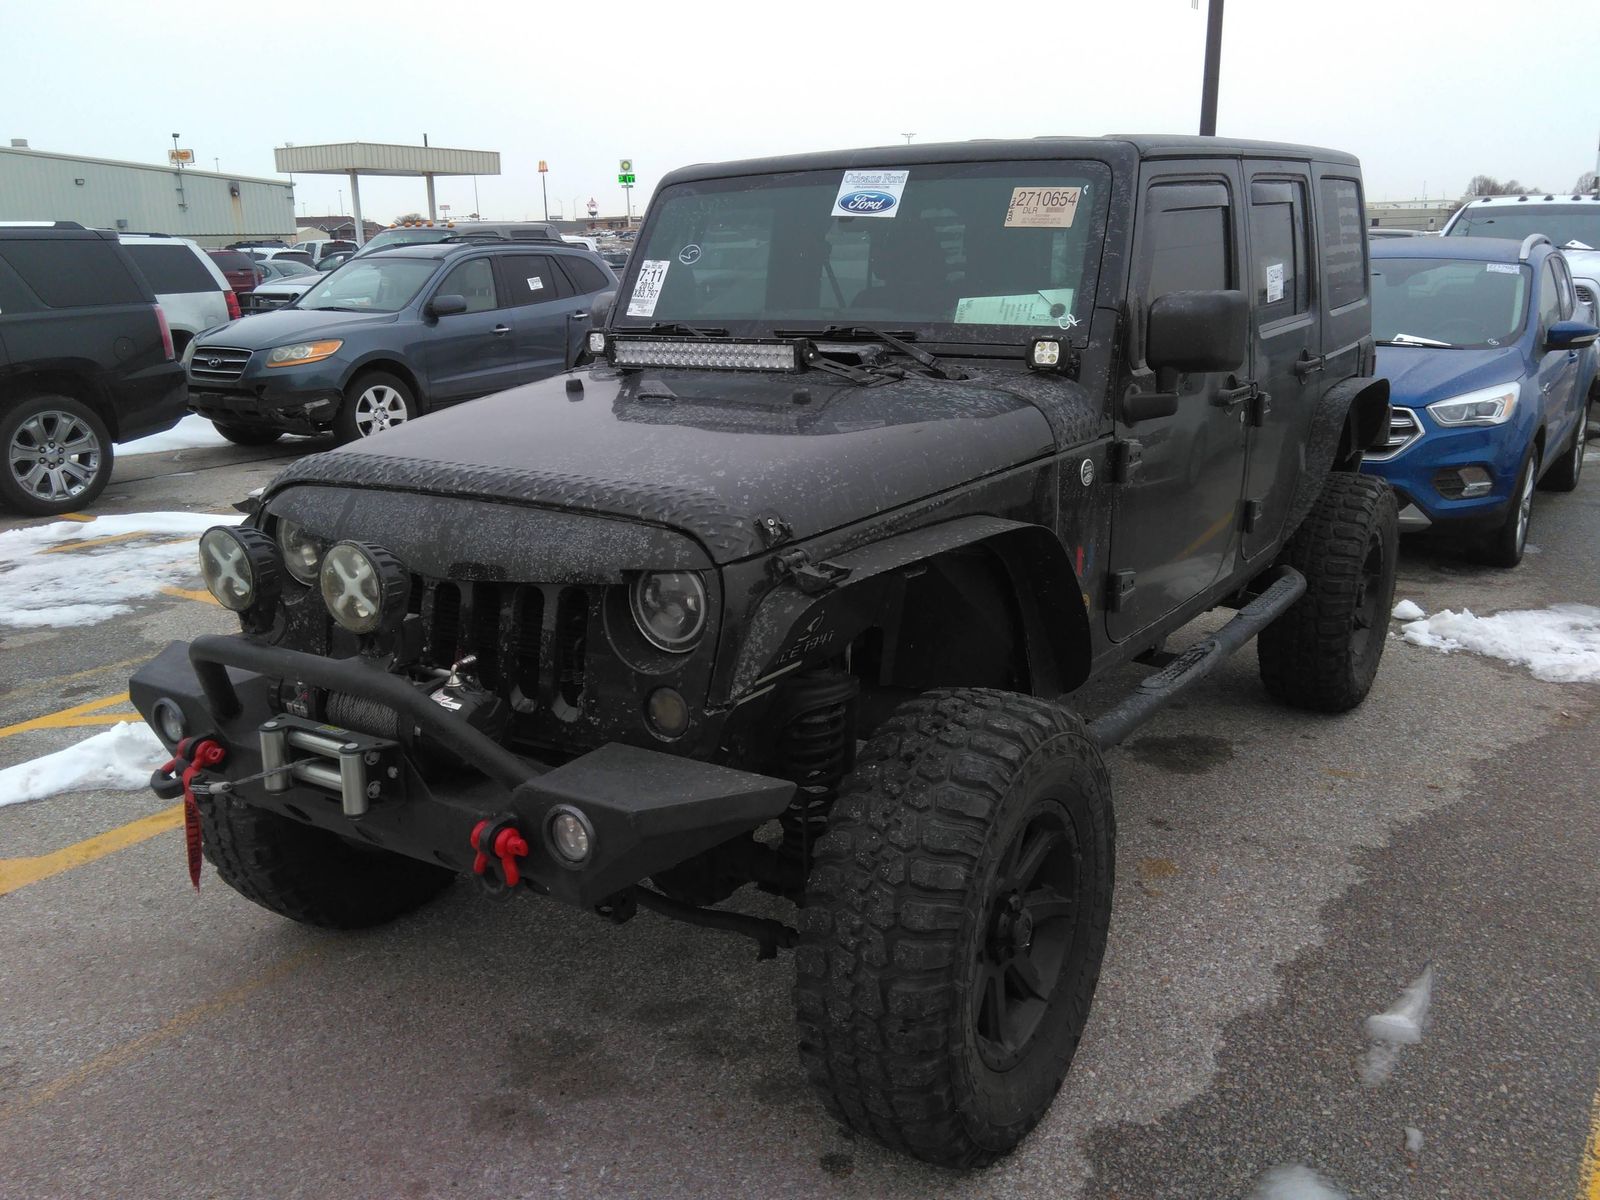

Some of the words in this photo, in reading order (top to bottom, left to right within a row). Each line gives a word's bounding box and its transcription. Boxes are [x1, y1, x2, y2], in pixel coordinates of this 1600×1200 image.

[881, 172, 907, 184] Ford
[848, 193, 886, 210] Ford
[1016, 191, 1078, 207] 2710654
[639, 268, 664, 282] 7:11
[640, 281, 655, 290] 2013
